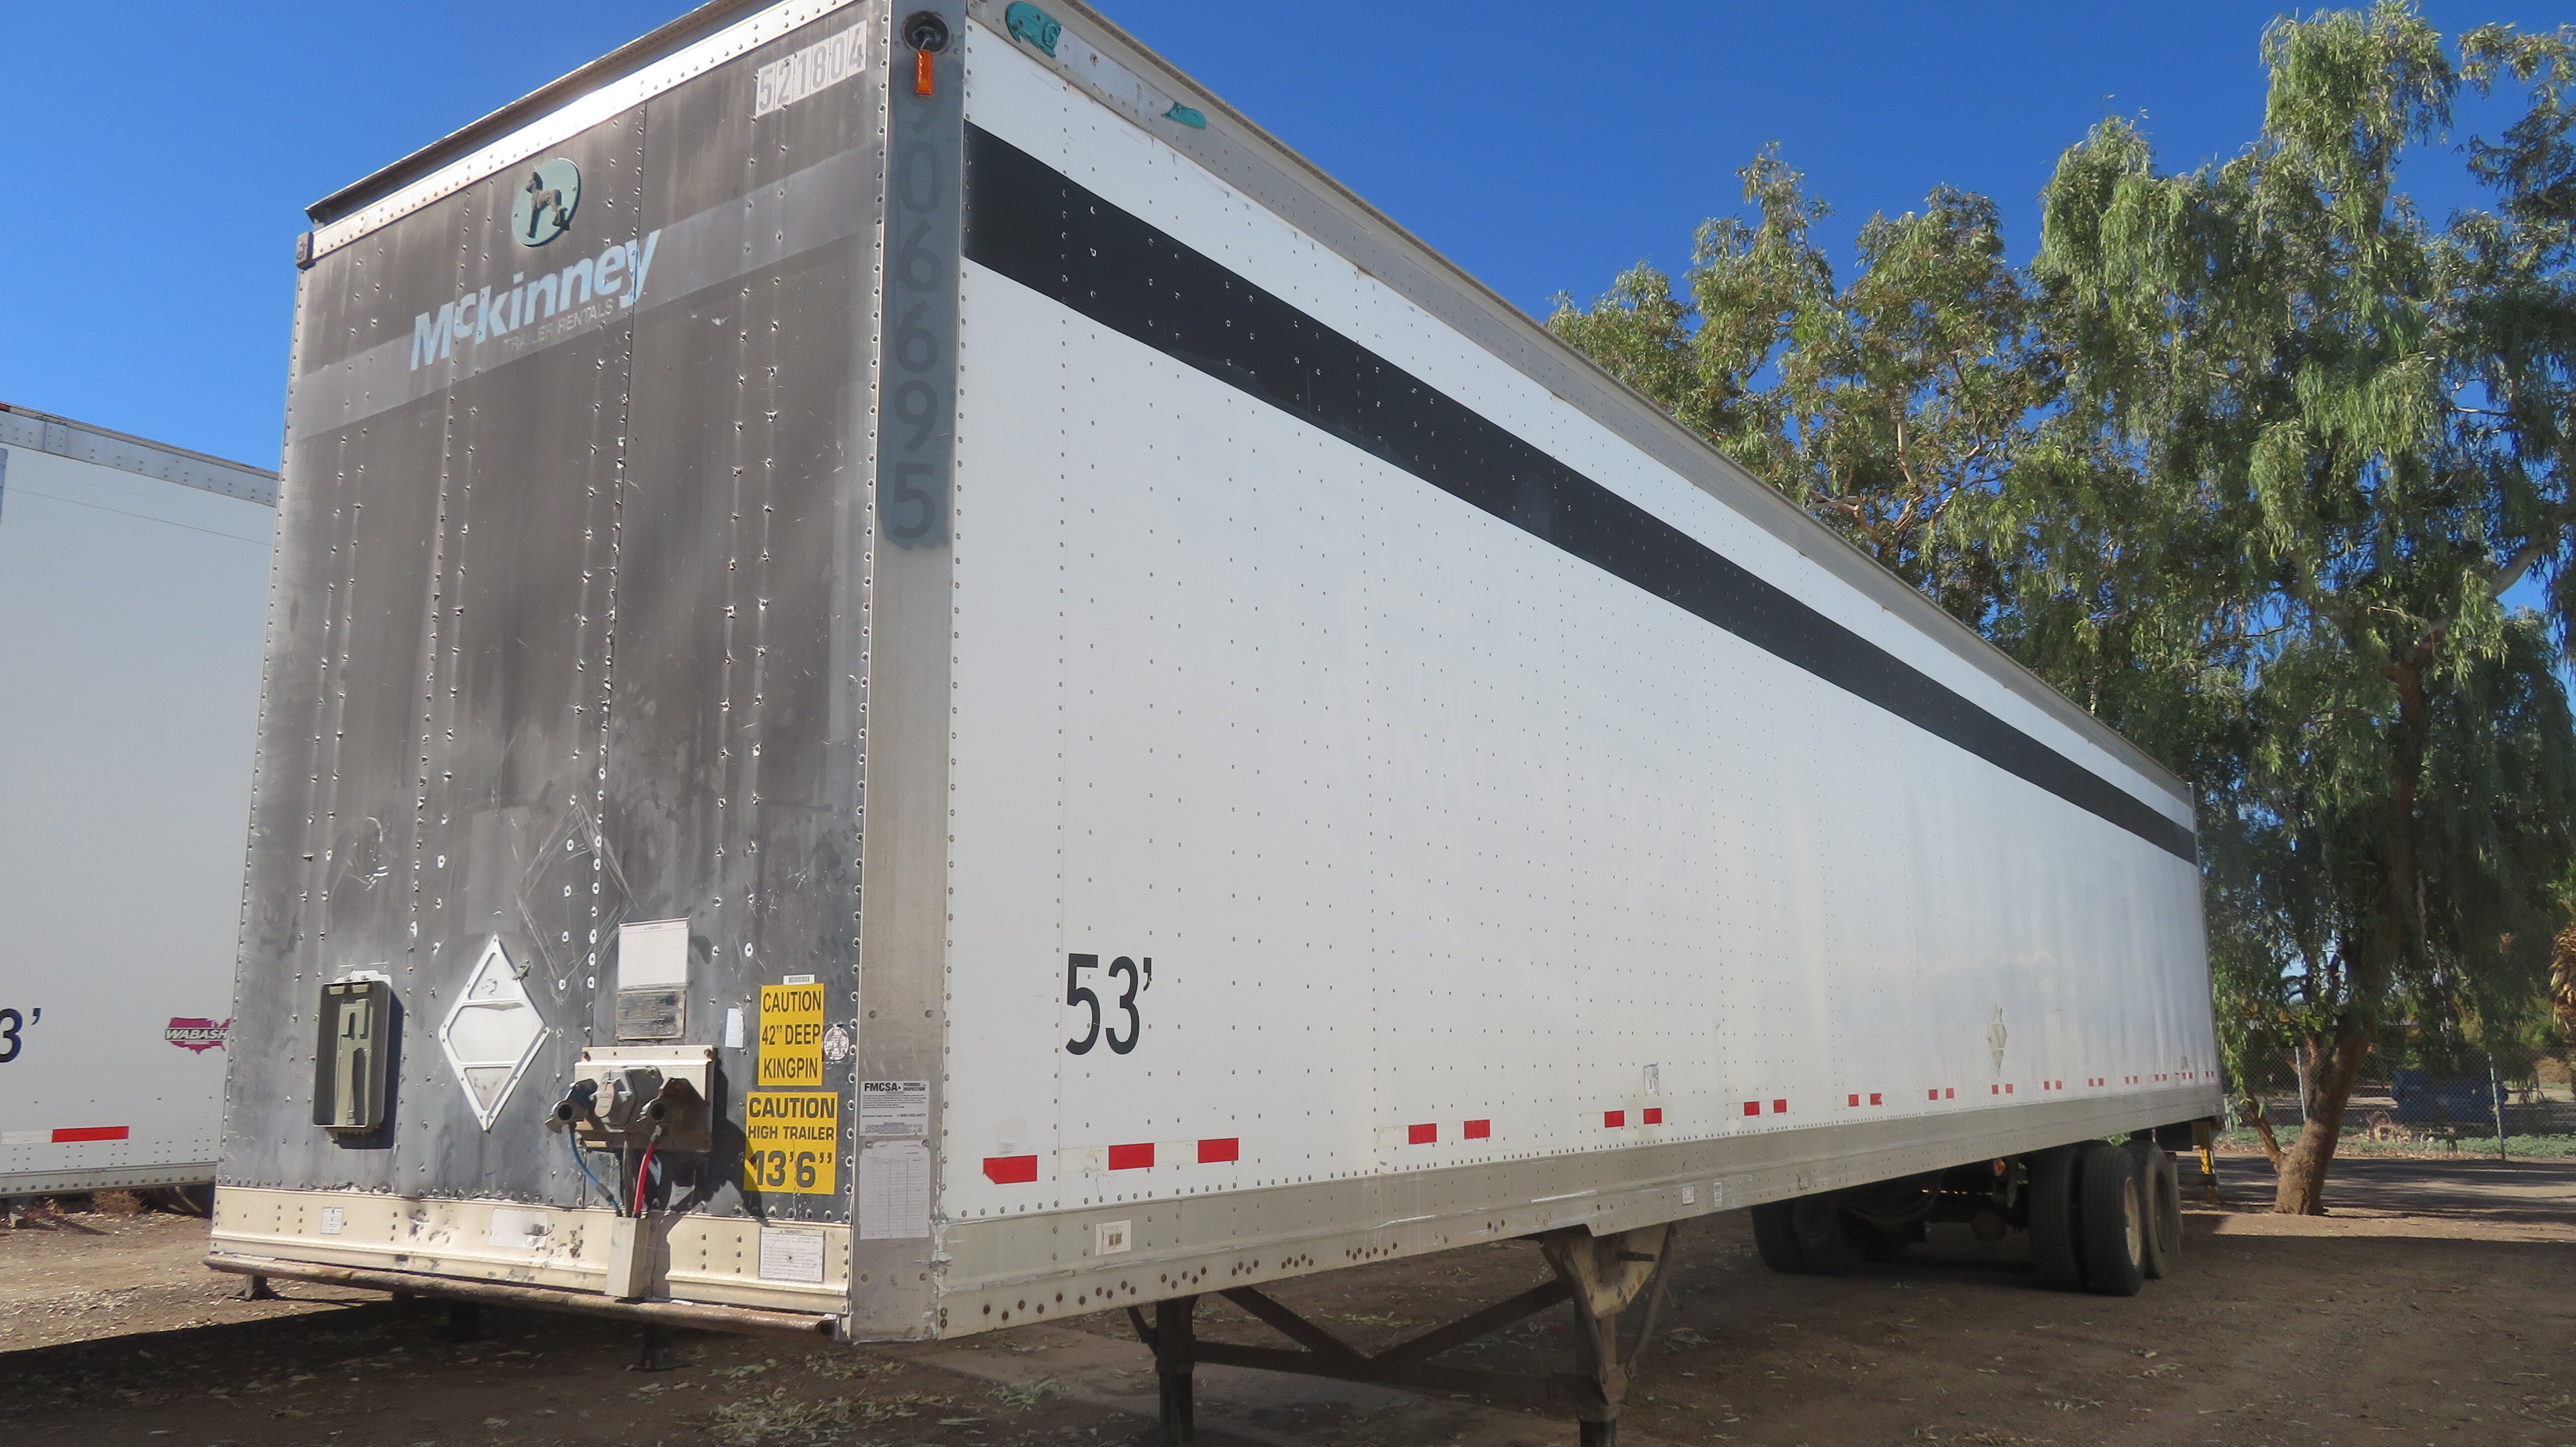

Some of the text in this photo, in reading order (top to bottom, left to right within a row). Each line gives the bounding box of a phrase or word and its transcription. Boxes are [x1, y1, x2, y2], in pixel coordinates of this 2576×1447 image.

[759, 27, 864, 110] 521804
[558, 298, 614, 334] RENTALS
[763, 990, 821, 1013] CAUTION
[1065, 953, 1151, 1055] 53'
[166, 1029, 229, 1039] WABASH
[762, 1024, 820, 1045] 42" DEEP
[764, 1057, 818, 1078] KINGPIN
[749, 1097, 835, 1119] CAUTION
[748, 1125, 834, 1140] HIGH TRAILER
